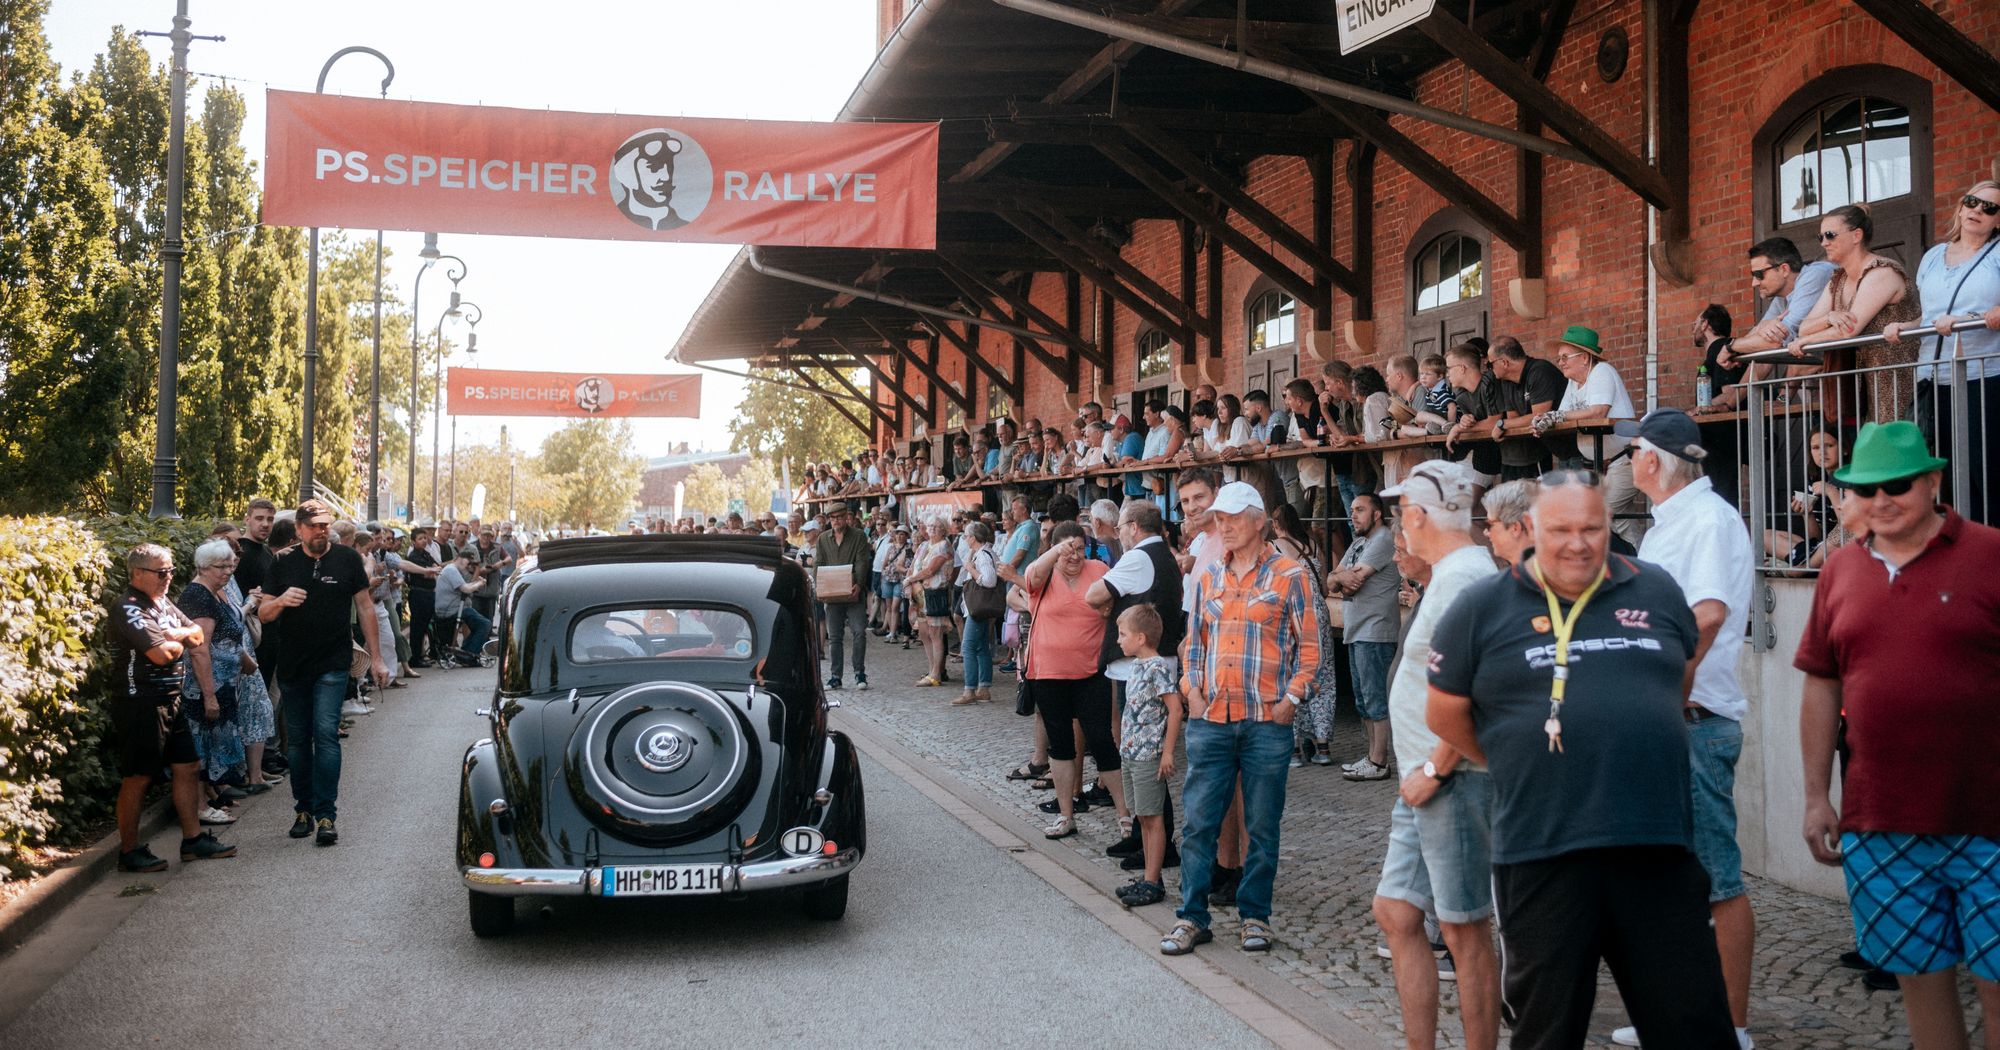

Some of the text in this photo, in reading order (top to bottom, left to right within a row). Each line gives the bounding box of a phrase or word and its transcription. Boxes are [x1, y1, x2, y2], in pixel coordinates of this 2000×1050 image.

[315, 148, 877, 202] PS.SPEICHER RALLYE
[464, 386, 569, 401] PS.SPEICHER
[1614, 608, 1649, 621] 911
[796, 831, 812, 855] D
[616, 868, 722, 891] HH MB 11H
